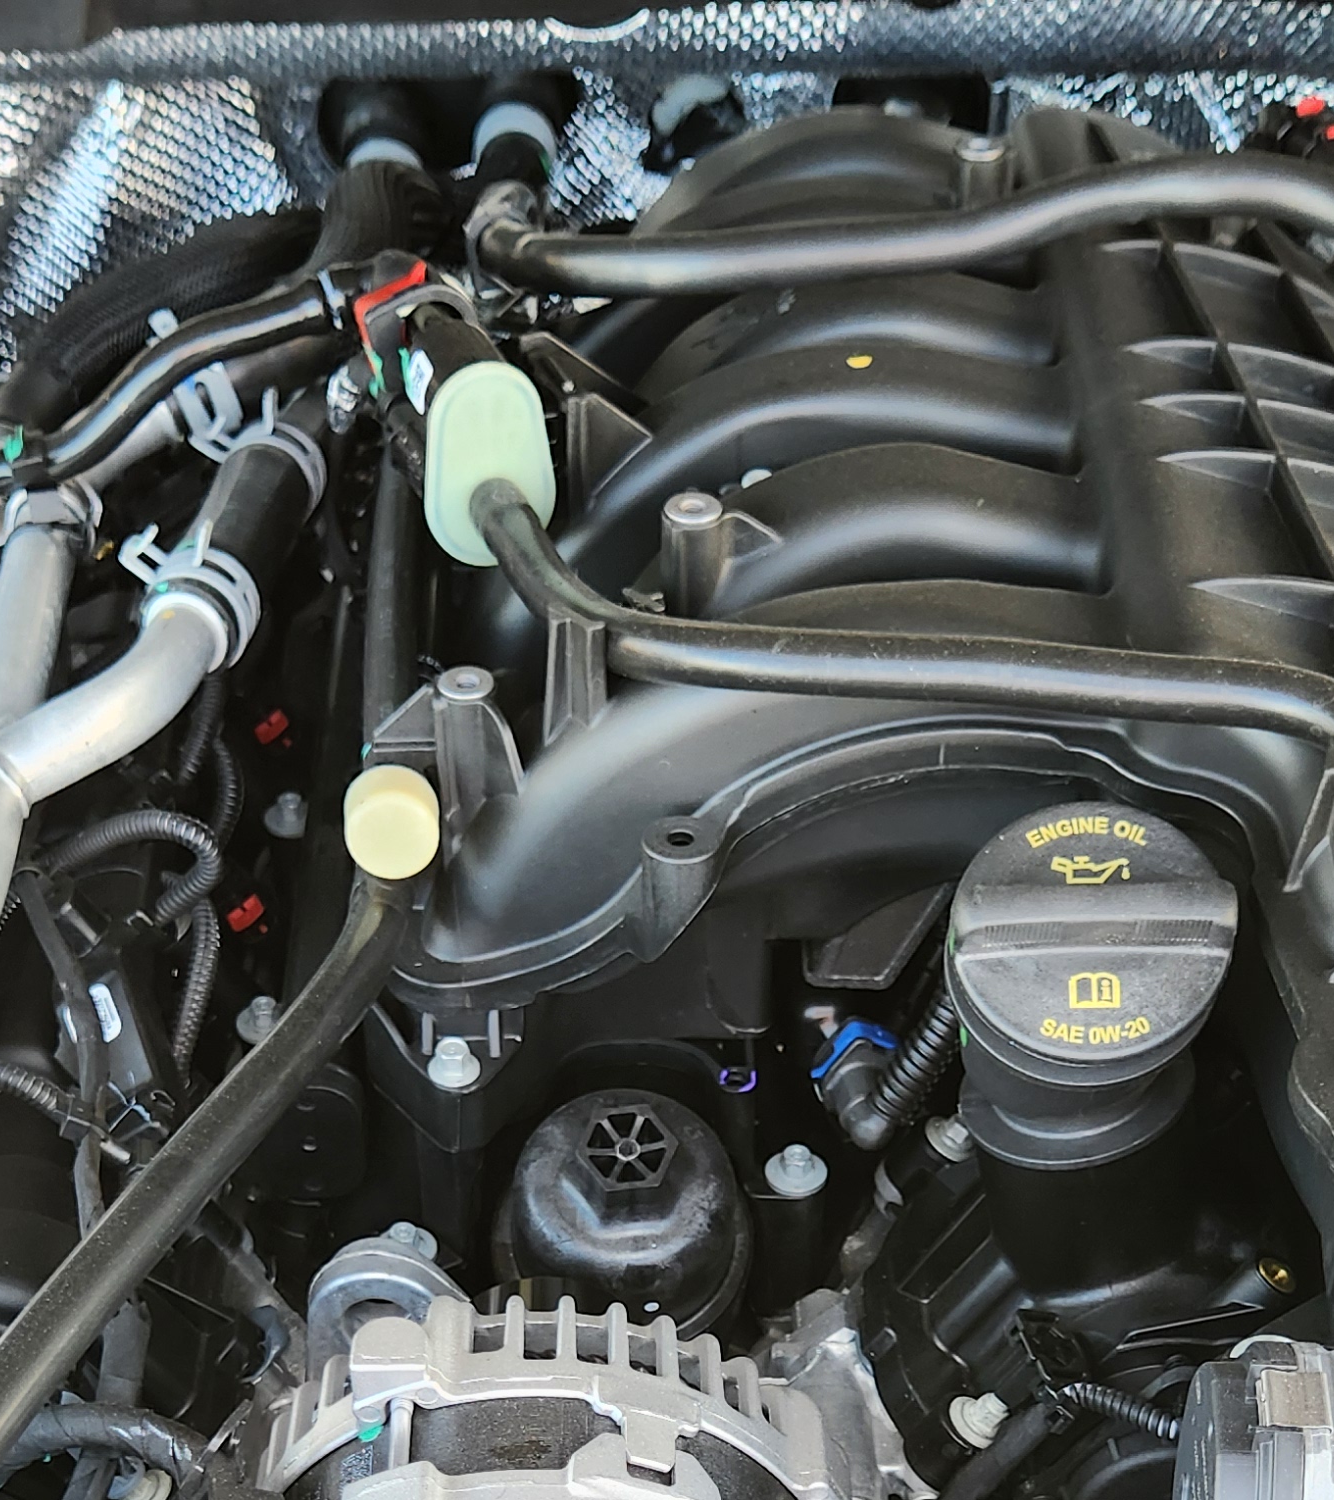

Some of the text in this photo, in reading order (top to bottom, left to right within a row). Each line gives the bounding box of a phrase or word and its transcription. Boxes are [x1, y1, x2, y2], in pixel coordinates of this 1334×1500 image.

[1025, 816, 1148, 848] ENGINE OIL
[1040, 1016, 1150, 1044] SAE 0W-20
